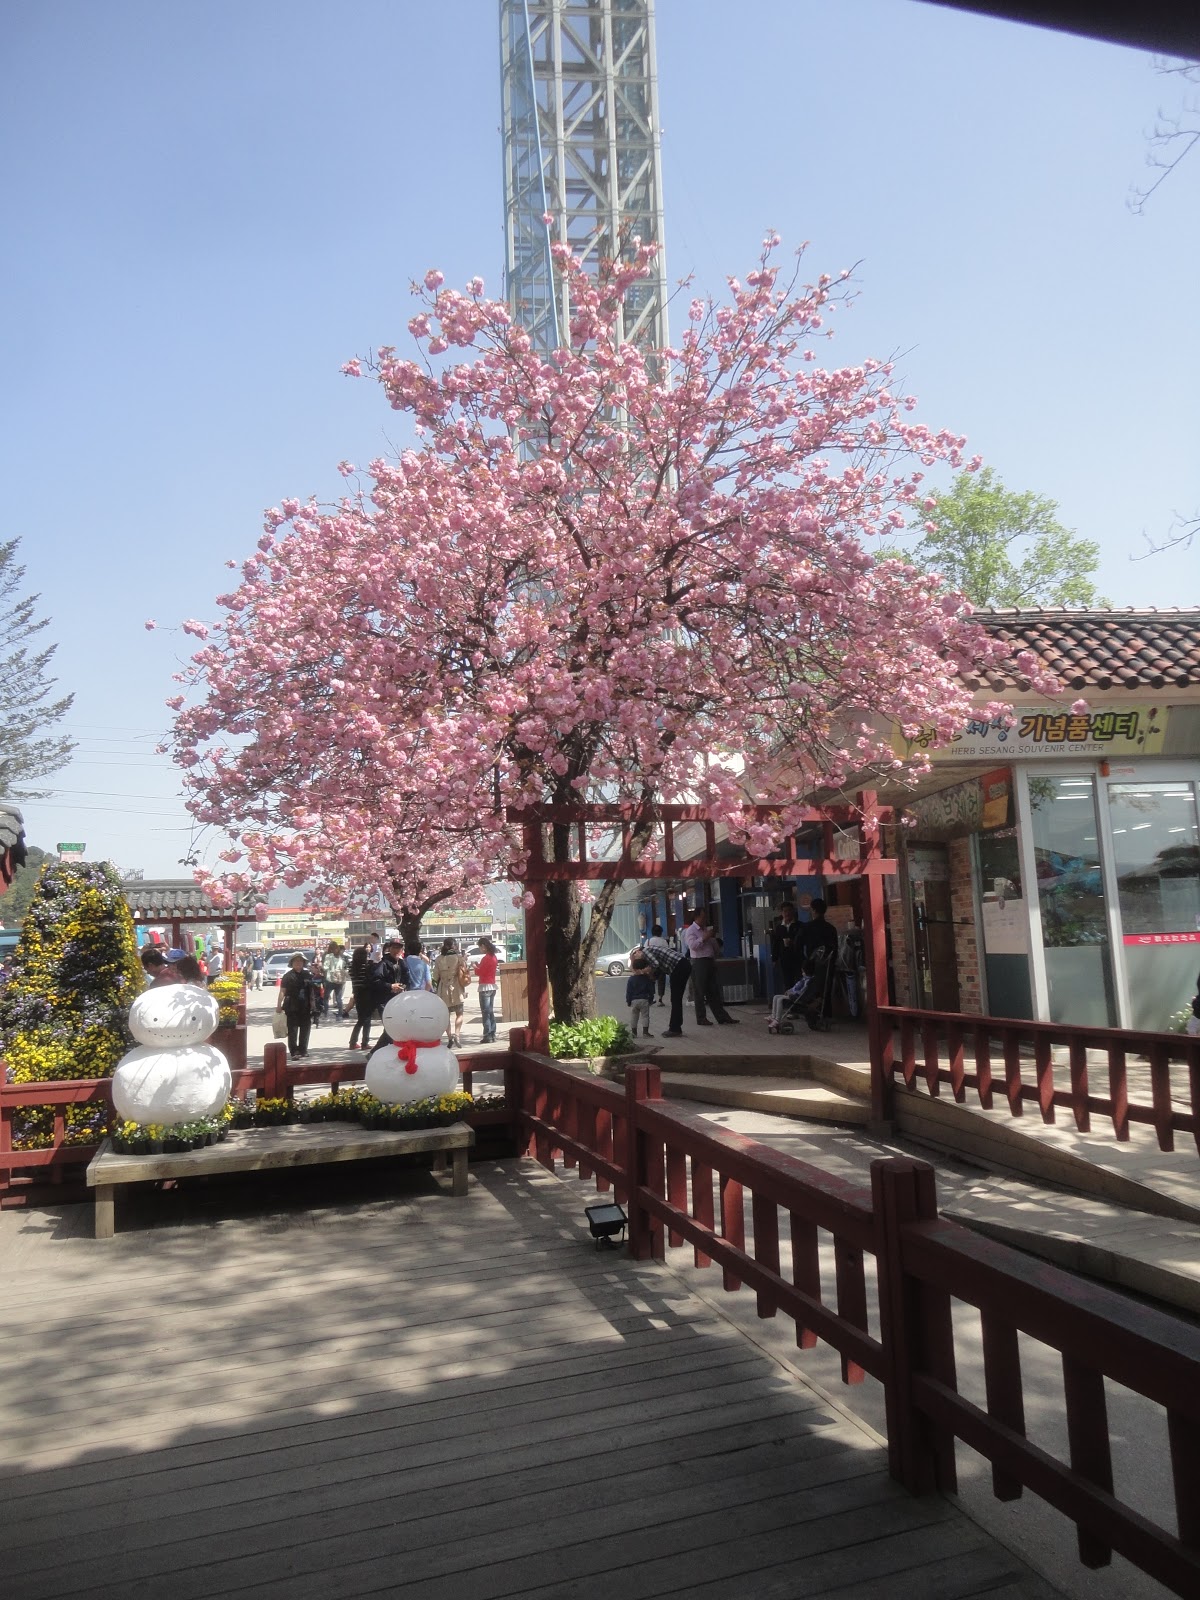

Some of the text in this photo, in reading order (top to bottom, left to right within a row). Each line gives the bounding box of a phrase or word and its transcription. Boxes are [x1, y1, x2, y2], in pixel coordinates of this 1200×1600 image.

[1018, 712, 1138, 742] 기념품센터
[951, 743, 1105, 755] HERB SESANG SOUVENIR CENTER
